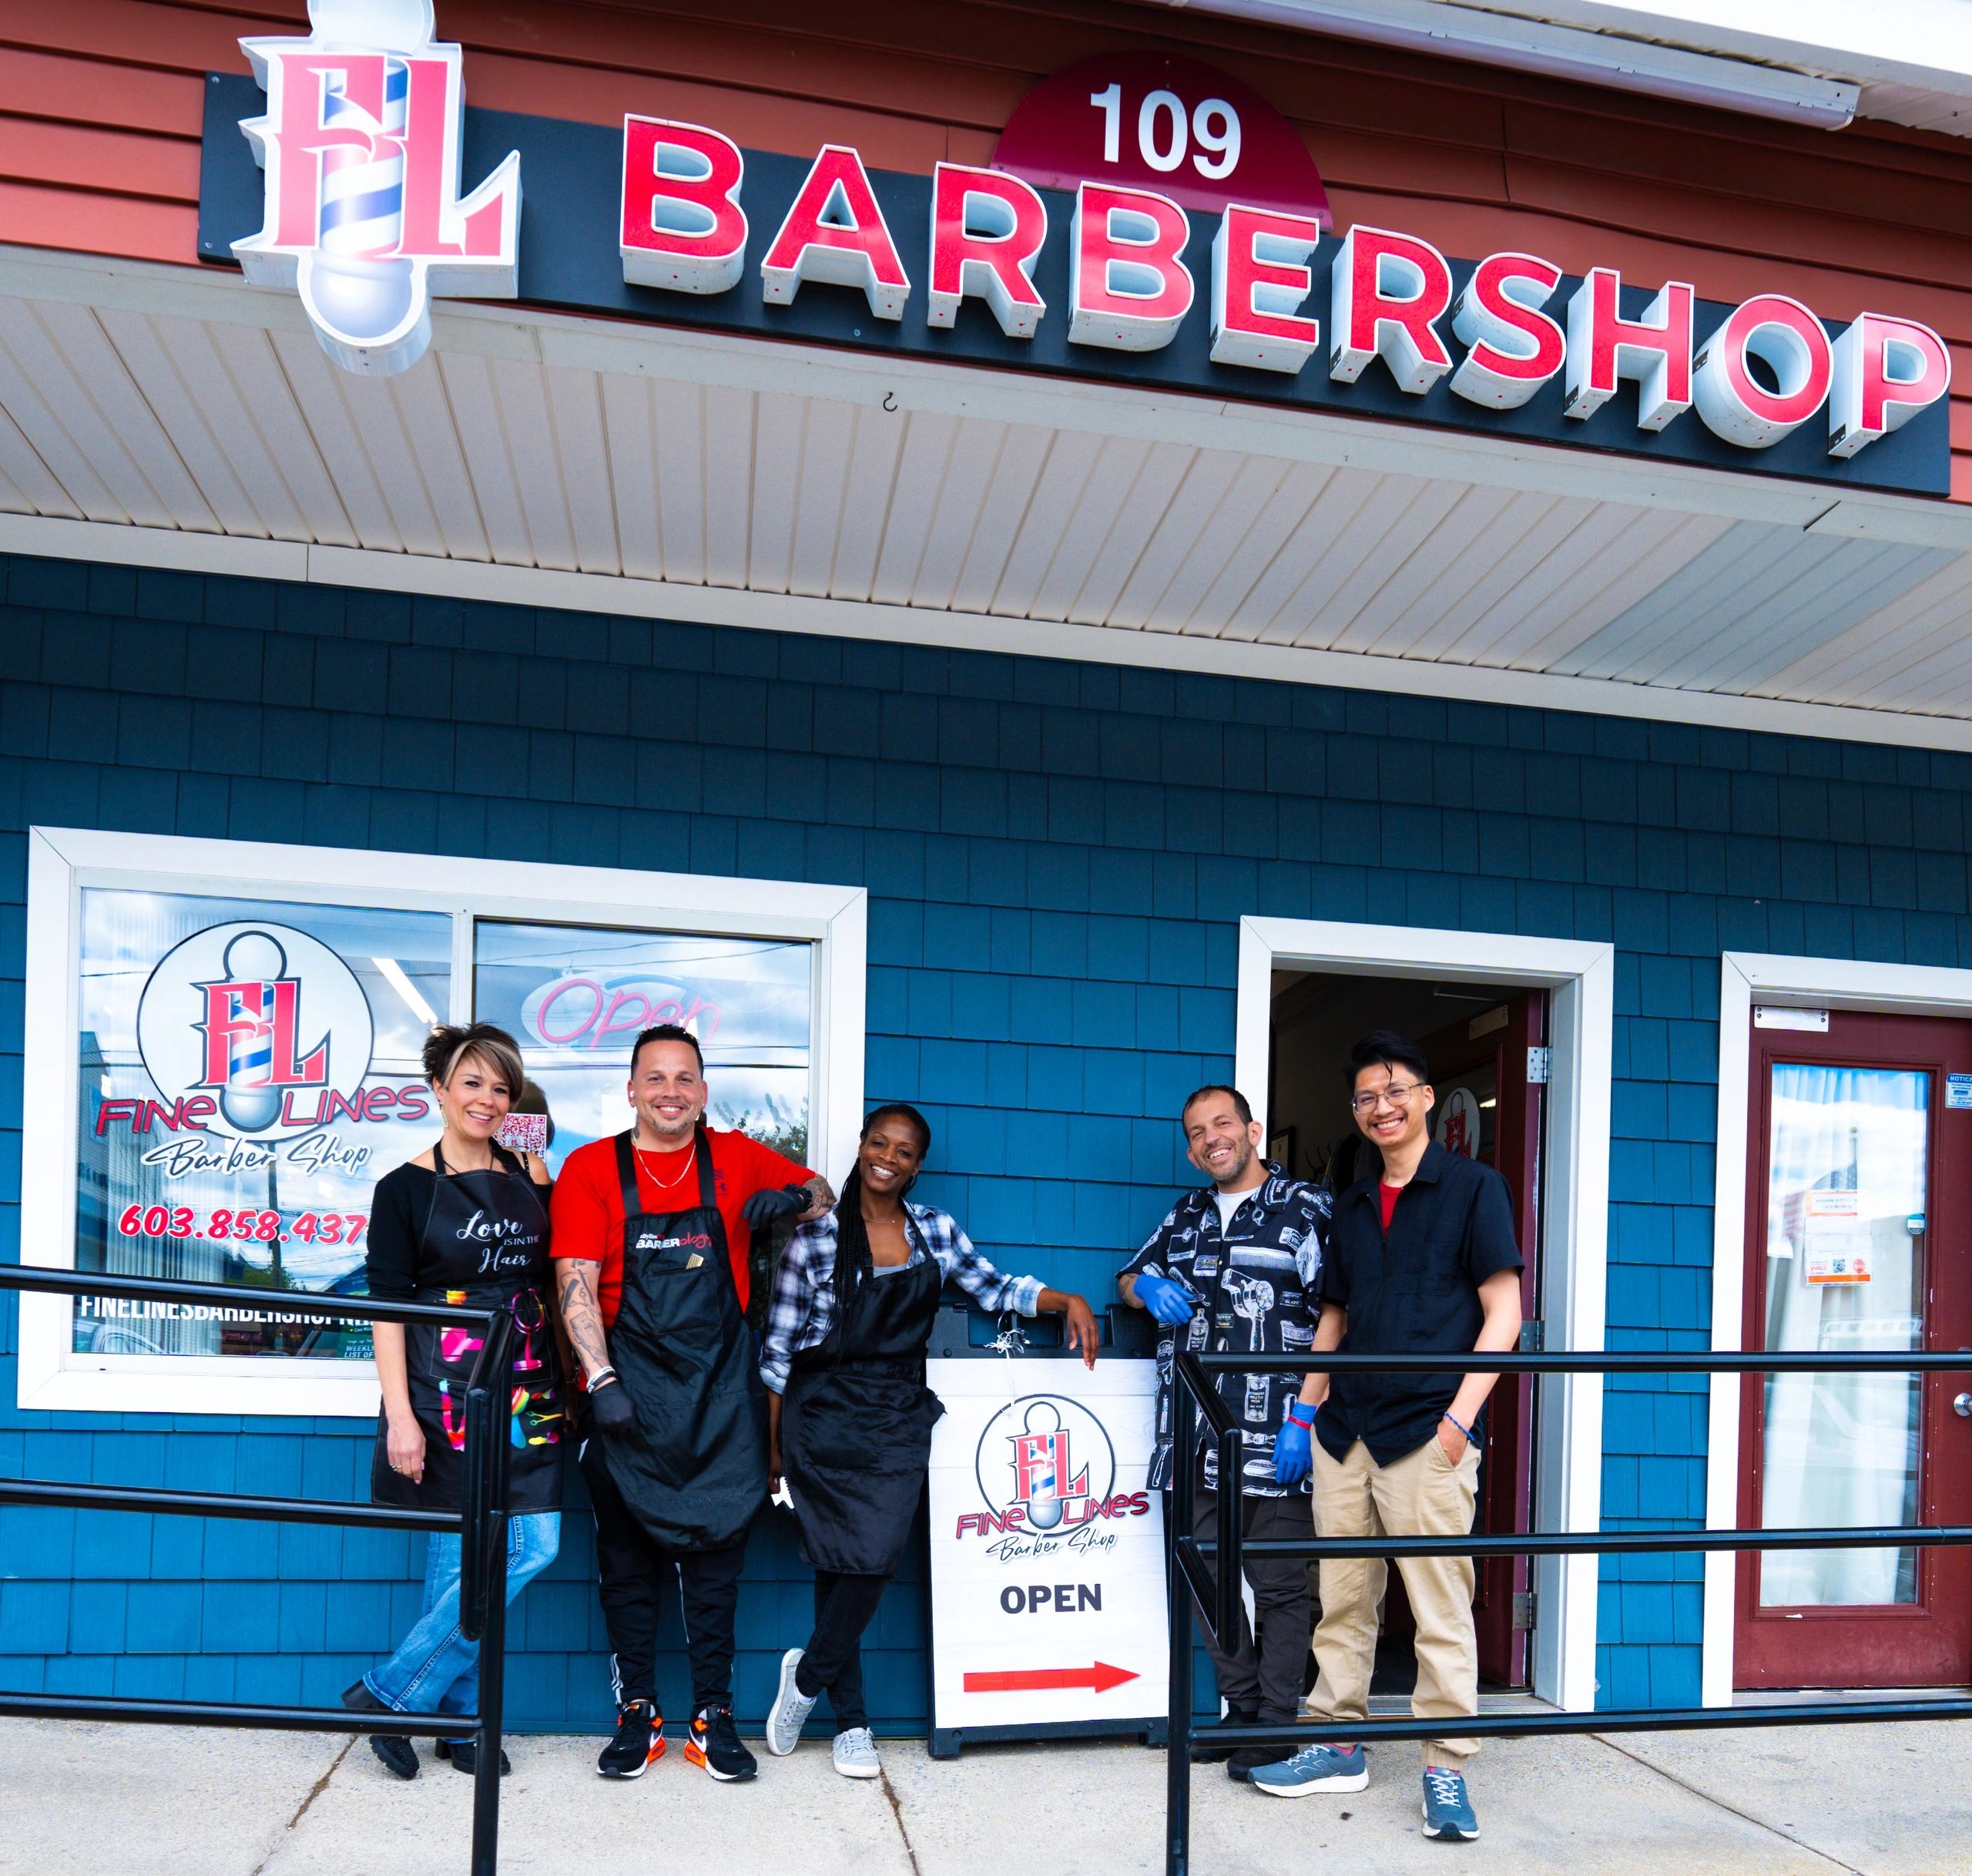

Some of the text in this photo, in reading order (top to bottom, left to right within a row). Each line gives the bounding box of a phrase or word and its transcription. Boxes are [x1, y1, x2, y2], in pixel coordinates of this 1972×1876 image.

[1089, 82, 1242, 180] 109
[619, 112, 1952, 456] BARBERSHOP
[537, 978, 721, 1049] Open
[143, 1134, 372, 1178] Barber Shop
[118, 1203, 369, 1247] 603.858.437
[456, 1210, 523, 1242] Love
[636, 1231, 713, 1250] BARERology
[478, 1246, 532, 1274] Hair
[985, 1526, 1115, 1562] Barber Shop
[1000, 1583, 1102, 1615] OPEN
